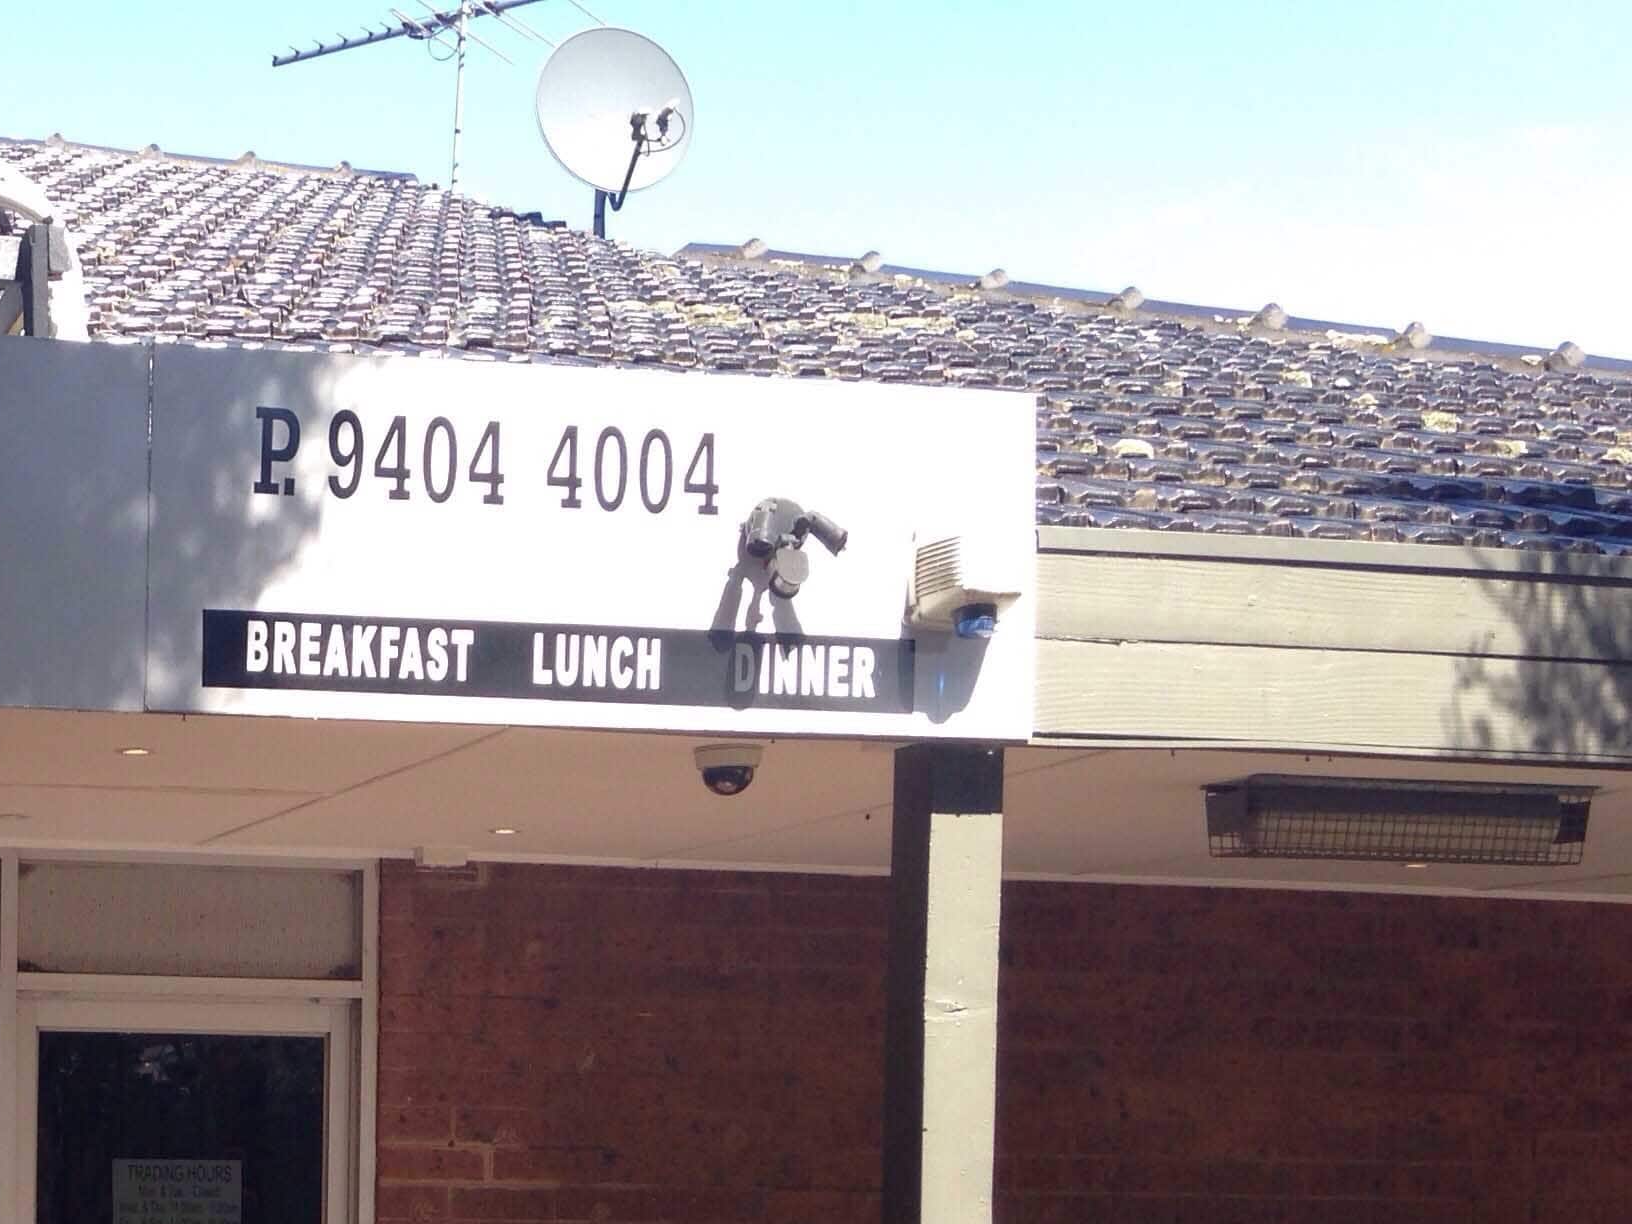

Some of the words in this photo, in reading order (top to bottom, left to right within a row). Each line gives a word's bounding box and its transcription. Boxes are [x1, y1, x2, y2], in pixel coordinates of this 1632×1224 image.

[253, 406, 301, 496] P.
[327, 409, 505, 505] 9404
[546, 425, 719, 515] 4004
[246, 619, 475, 683] BREAKFAST
[532, 632, 662, 691] LUNCH
[734, 643, 876, 699] DINNER
[128, 1164, 185, 1183] TRADING
[187, 1164, 233, 1184] HOURS
